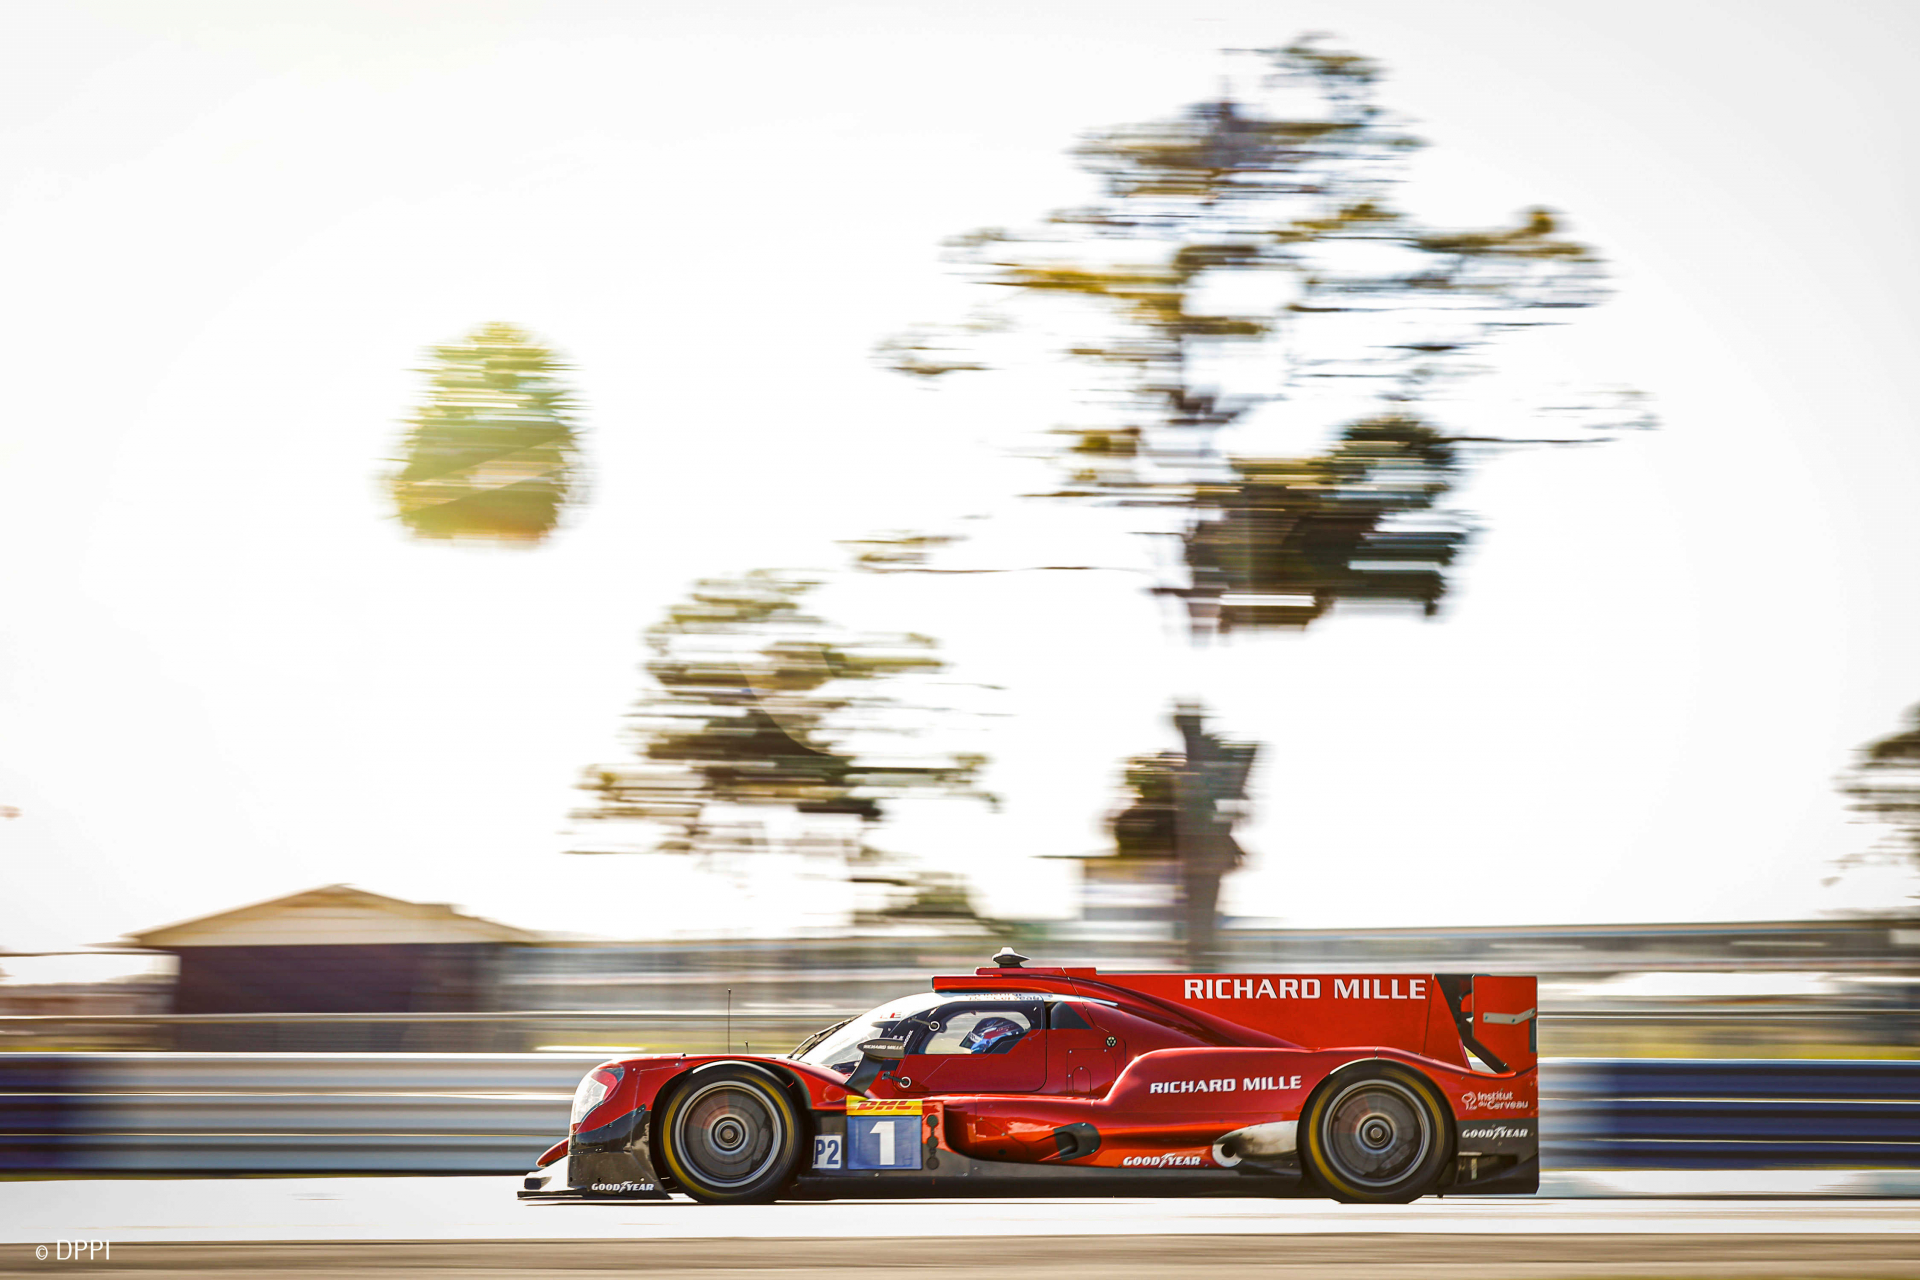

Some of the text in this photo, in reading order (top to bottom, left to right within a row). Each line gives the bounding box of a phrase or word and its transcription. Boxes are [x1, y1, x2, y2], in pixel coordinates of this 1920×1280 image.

[1184, 978, 1427, 1000] RICHARD MILLE
[1149, 1075, 1302, 1094] RICHARD MILLE
[1477, 1091, 1514, 1101] Institut
[855, 1100, 914, 1111] DHL
[1487, 1100, 1529, 1110] Cerveau
[1461, 1126, 1529, 1140] GOODYEAR
[869, 1121, 896, 1166] 1
[814, 1139, 840, 1165] P2
[1122, 1153, 1201, 1168] GOODYEAR
[591, 1181, 655, 1193] GOODYEAR
